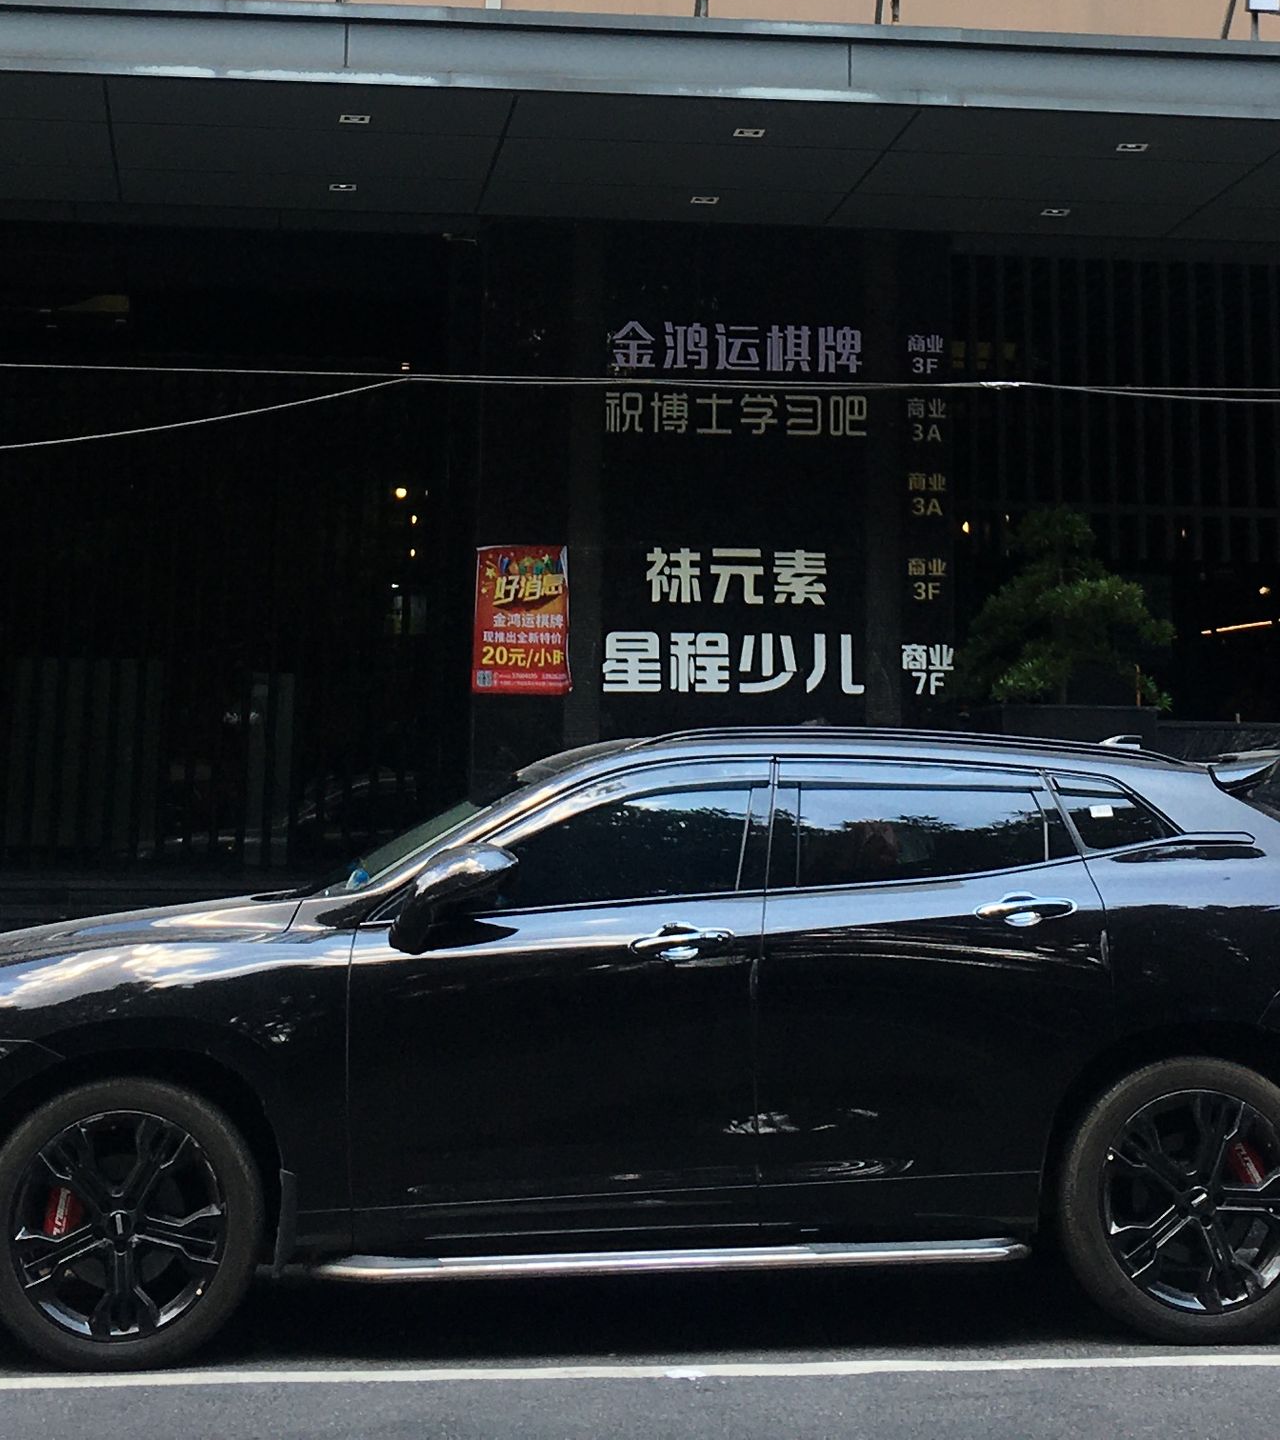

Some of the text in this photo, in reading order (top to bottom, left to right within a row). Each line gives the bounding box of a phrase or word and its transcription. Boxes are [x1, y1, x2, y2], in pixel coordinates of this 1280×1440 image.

[612, 320, 863, 374] 金鸿运棋牌
[907, 334, 945, 355] 商业
[912, 356, 939, 375] 3F
[907, 398, 947, 420] 商业
[912, 422, 942, 443] 3A
[911, 496, 943, 518] 3A
[645, 546, 828, 606] 袜元素
[912, 580, 942, 601] 3F
[492, 612, 564, 629] 金鸿运棋牌
[602, 630, 866, 696] 星程少儿
[901, 643, 955, 673] 商业
[913, 672, 945, 696] 7F
